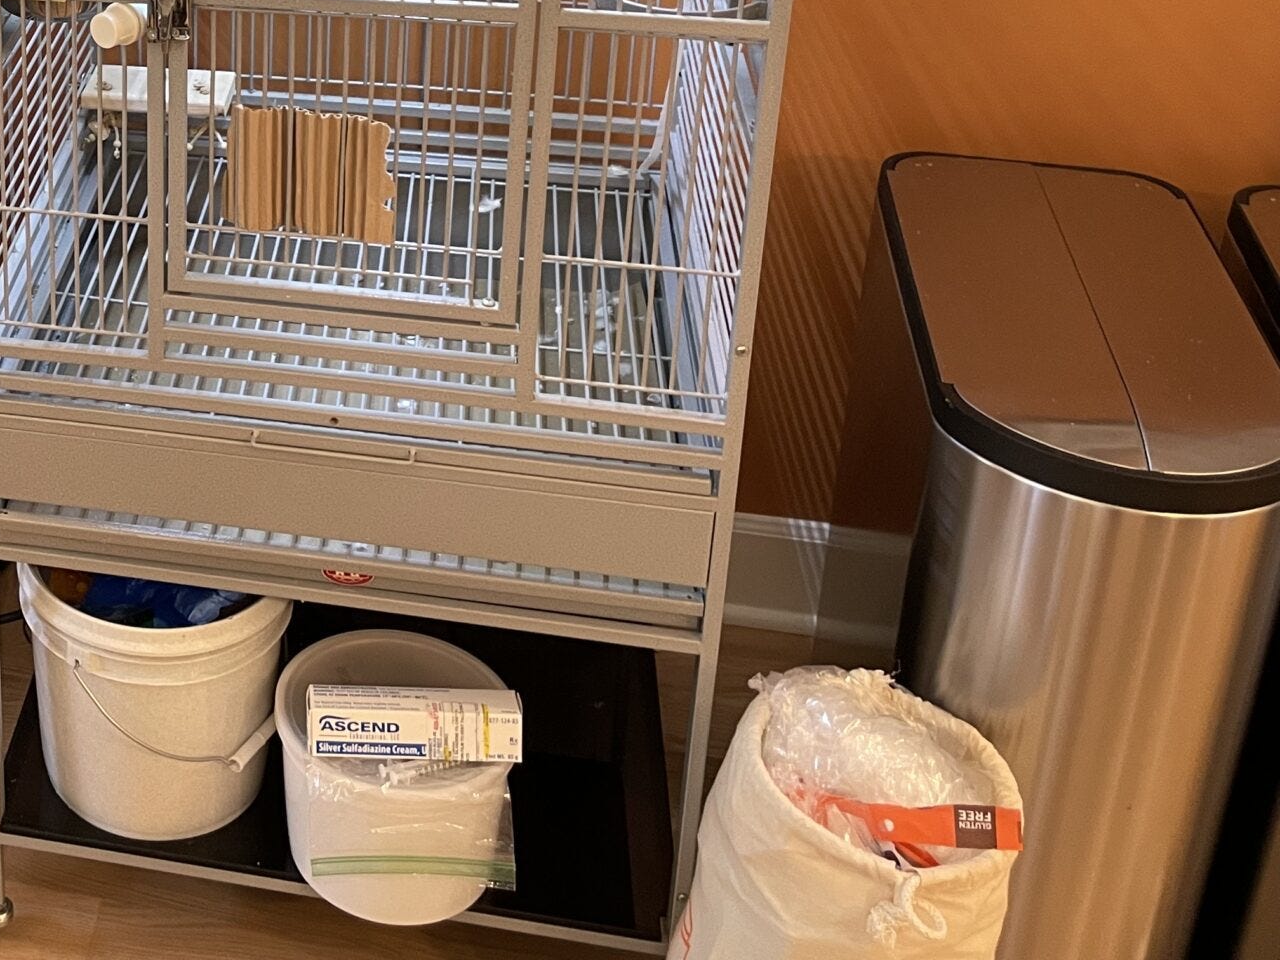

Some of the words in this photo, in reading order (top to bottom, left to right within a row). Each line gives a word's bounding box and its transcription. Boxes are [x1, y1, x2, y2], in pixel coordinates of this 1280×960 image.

[320, 720, 400, 733] ASCEND
[318, 742, 341, 752] Silver
[342, 742, 391, 754] Sulfadiazine
[392, 744, 420, 756] Cream,
[958, 809, 992, 822] FREE
[958, 820, 992, 830] GLUTEN
